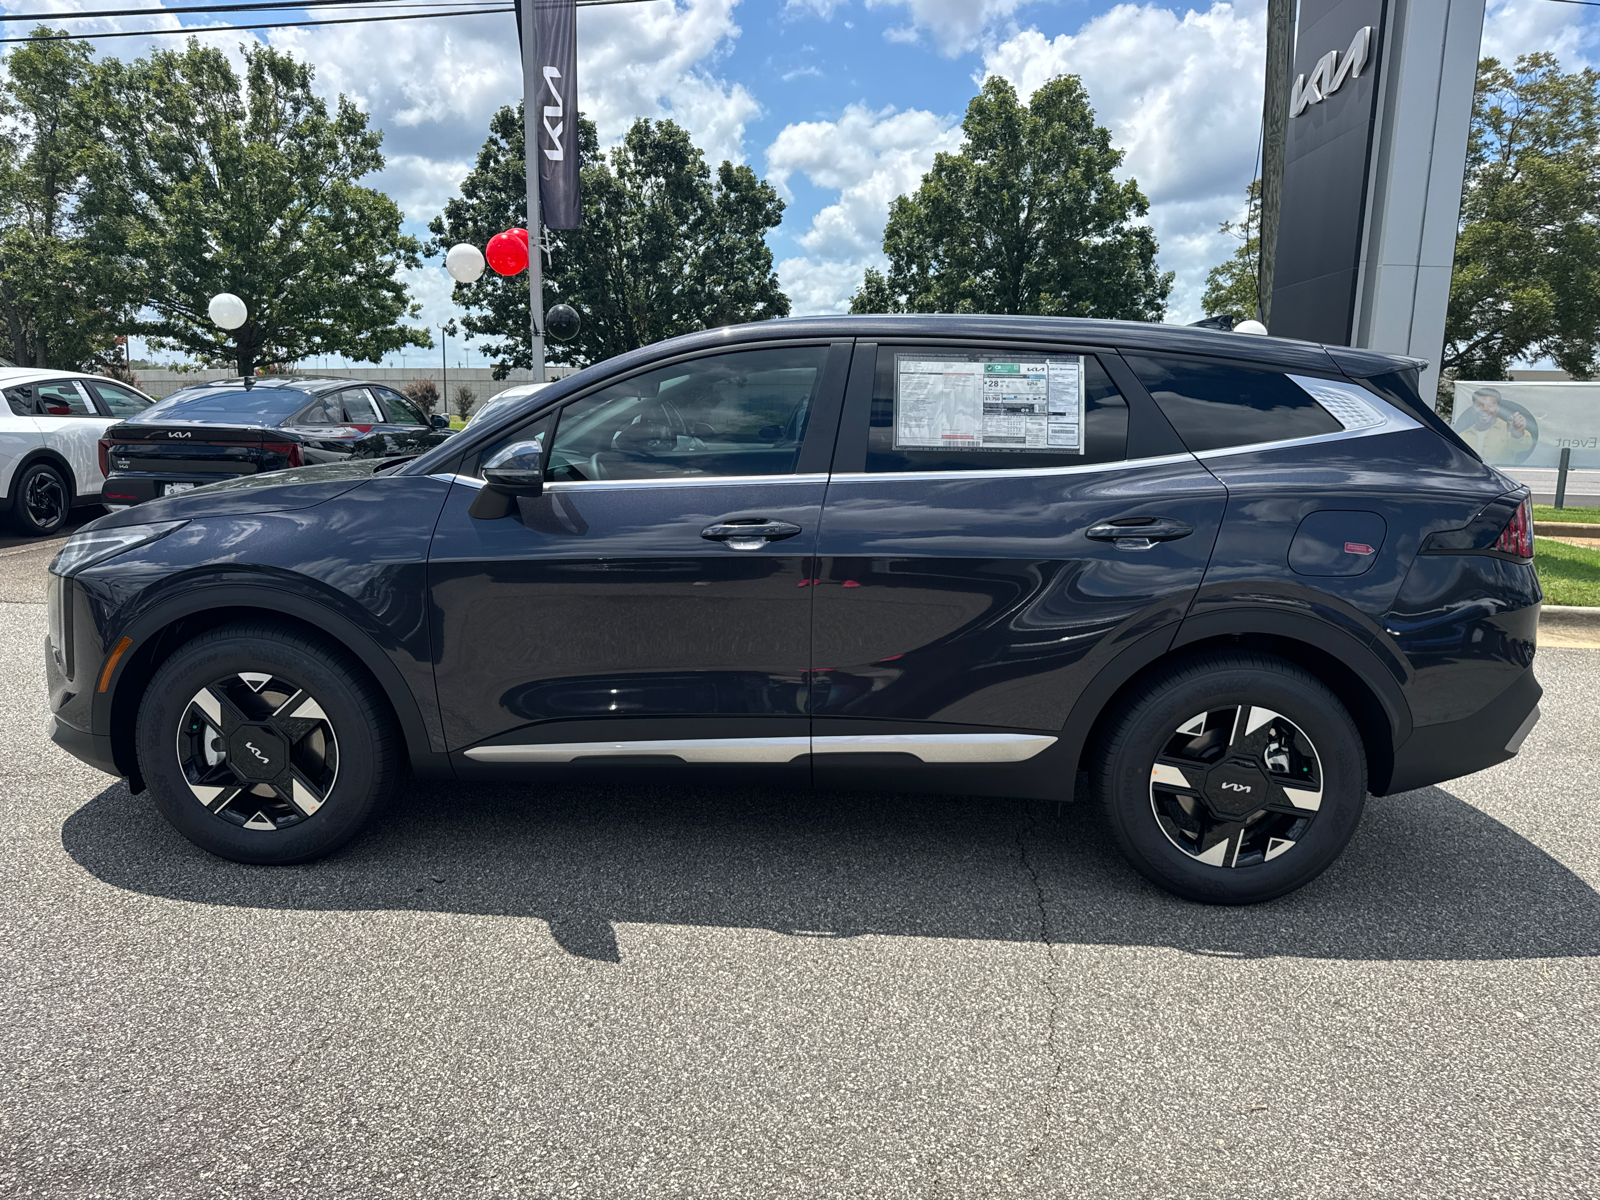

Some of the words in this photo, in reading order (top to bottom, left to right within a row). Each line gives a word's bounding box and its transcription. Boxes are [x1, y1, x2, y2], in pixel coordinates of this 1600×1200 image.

[1289, 26, 1371, 118] KIA
[543, 66, 563, 161] KIA
[988, 380, 999, 388] 28
[246, 742, 270, 764] KIA
[1221, 781, 1252, 793] KIA
